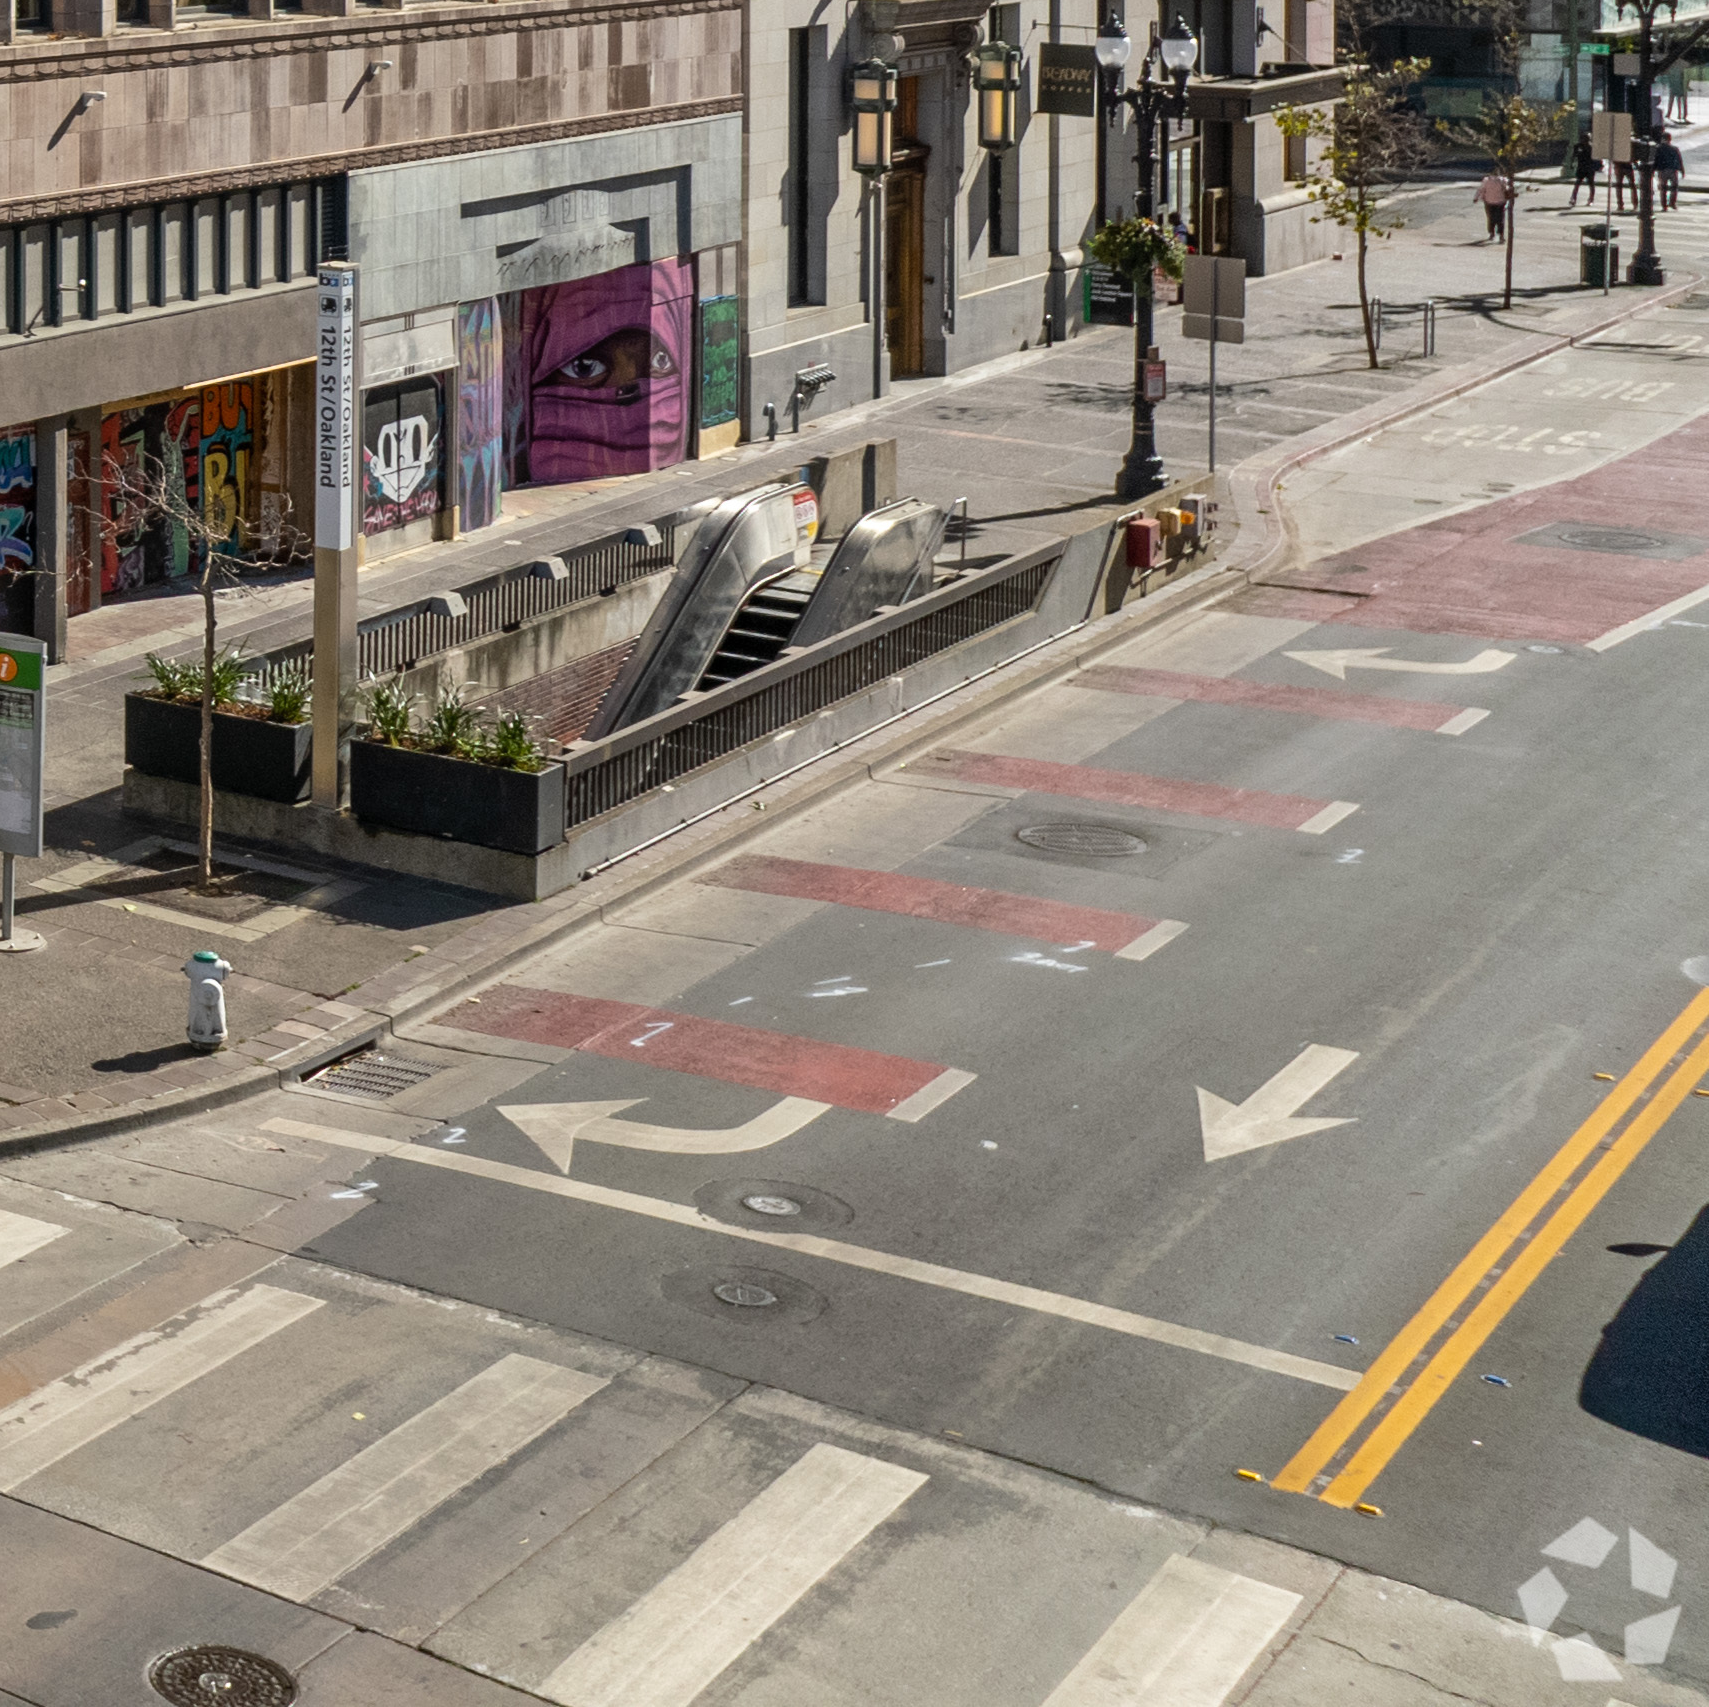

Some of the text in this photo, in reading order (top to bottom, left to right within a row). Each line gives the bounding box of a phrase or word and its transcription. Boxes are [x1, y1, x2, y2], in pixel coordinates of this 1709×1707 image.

[320, 326, 337, 488] 12th St/Oakland
[342, 326, 352, 487] 12th St/Oakland
